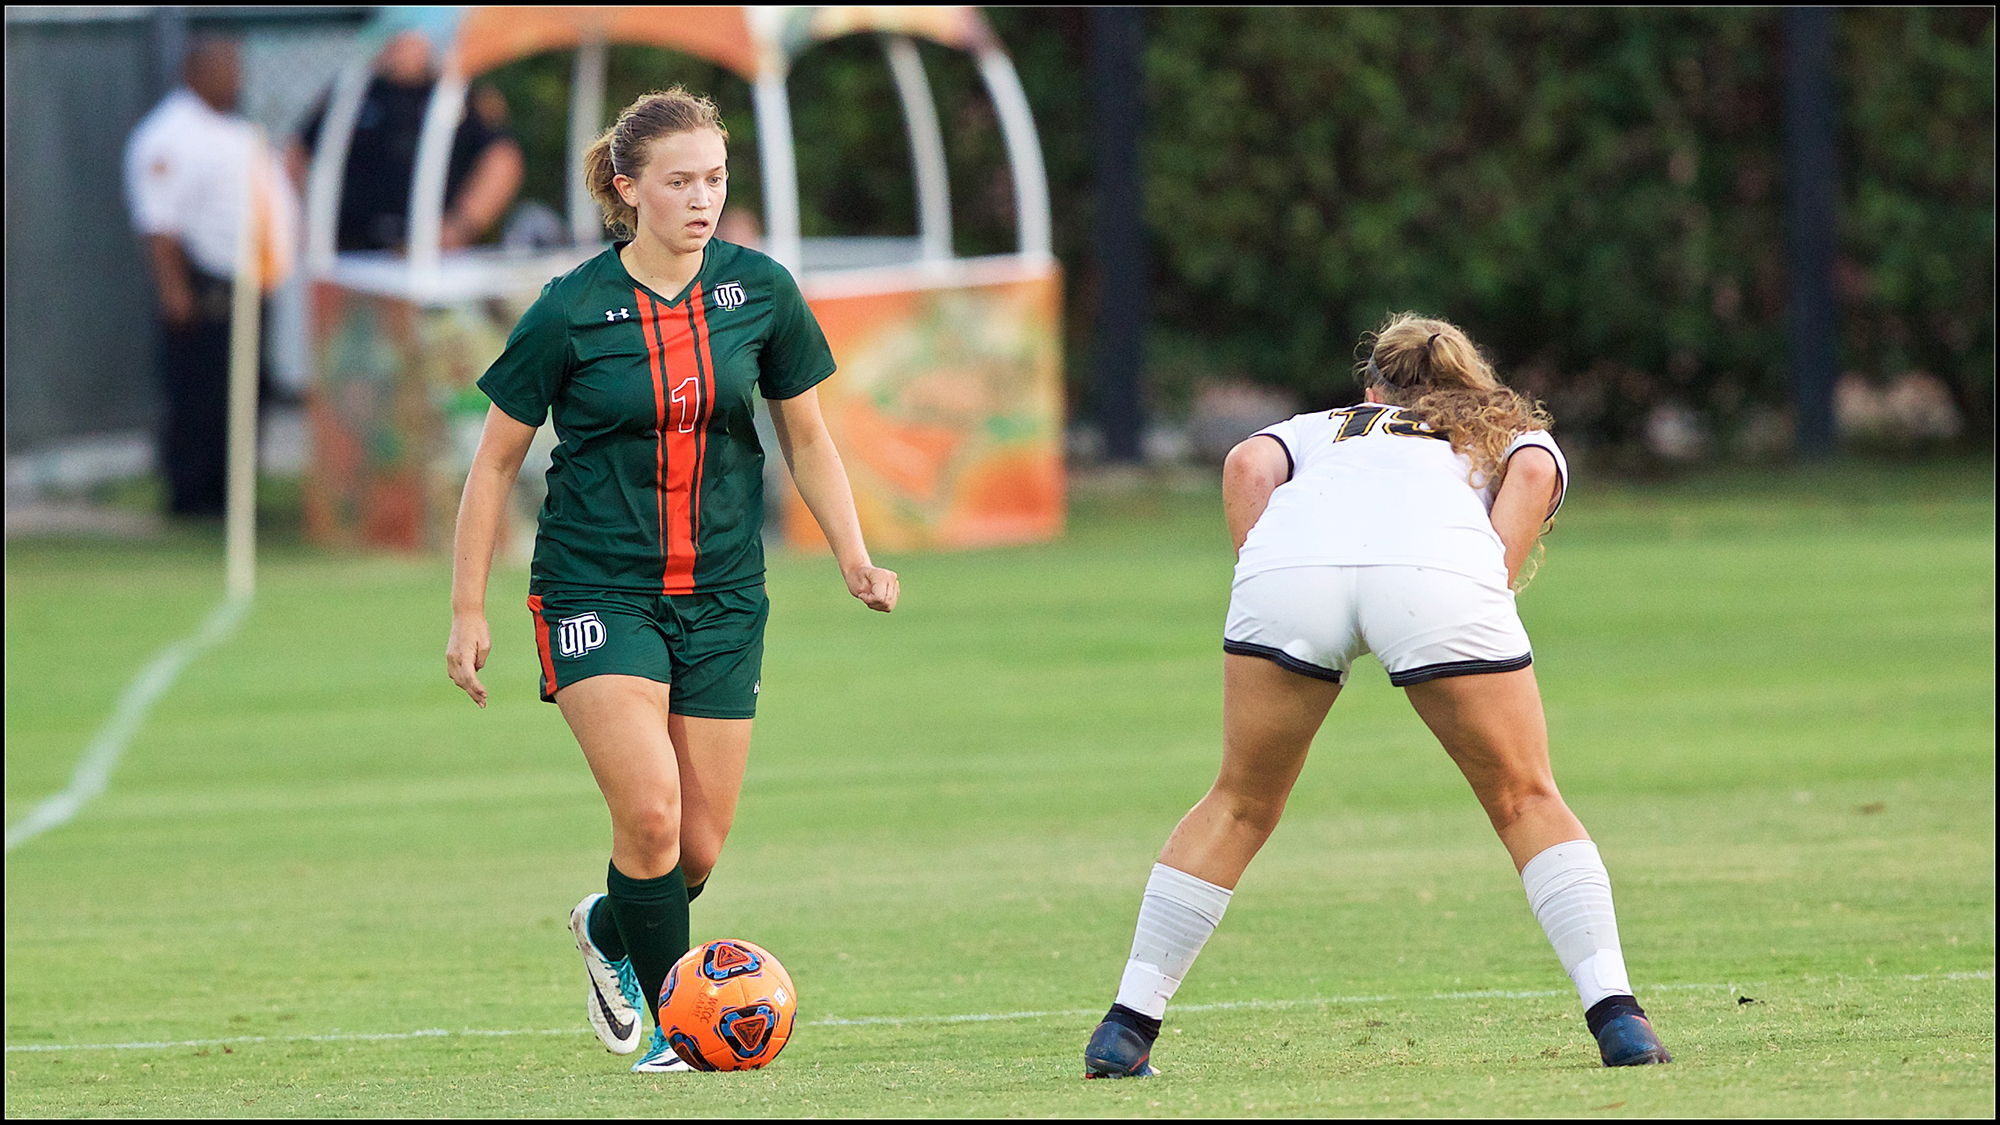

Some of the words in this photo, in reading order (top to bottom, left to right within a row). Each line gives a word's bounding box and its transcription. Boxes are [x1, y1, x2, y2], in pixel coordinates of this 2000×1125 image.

[712, 280, 747, 311] UTD
[671, 376, 700, 433] 1
[557, 611, 607, 658] UTD
